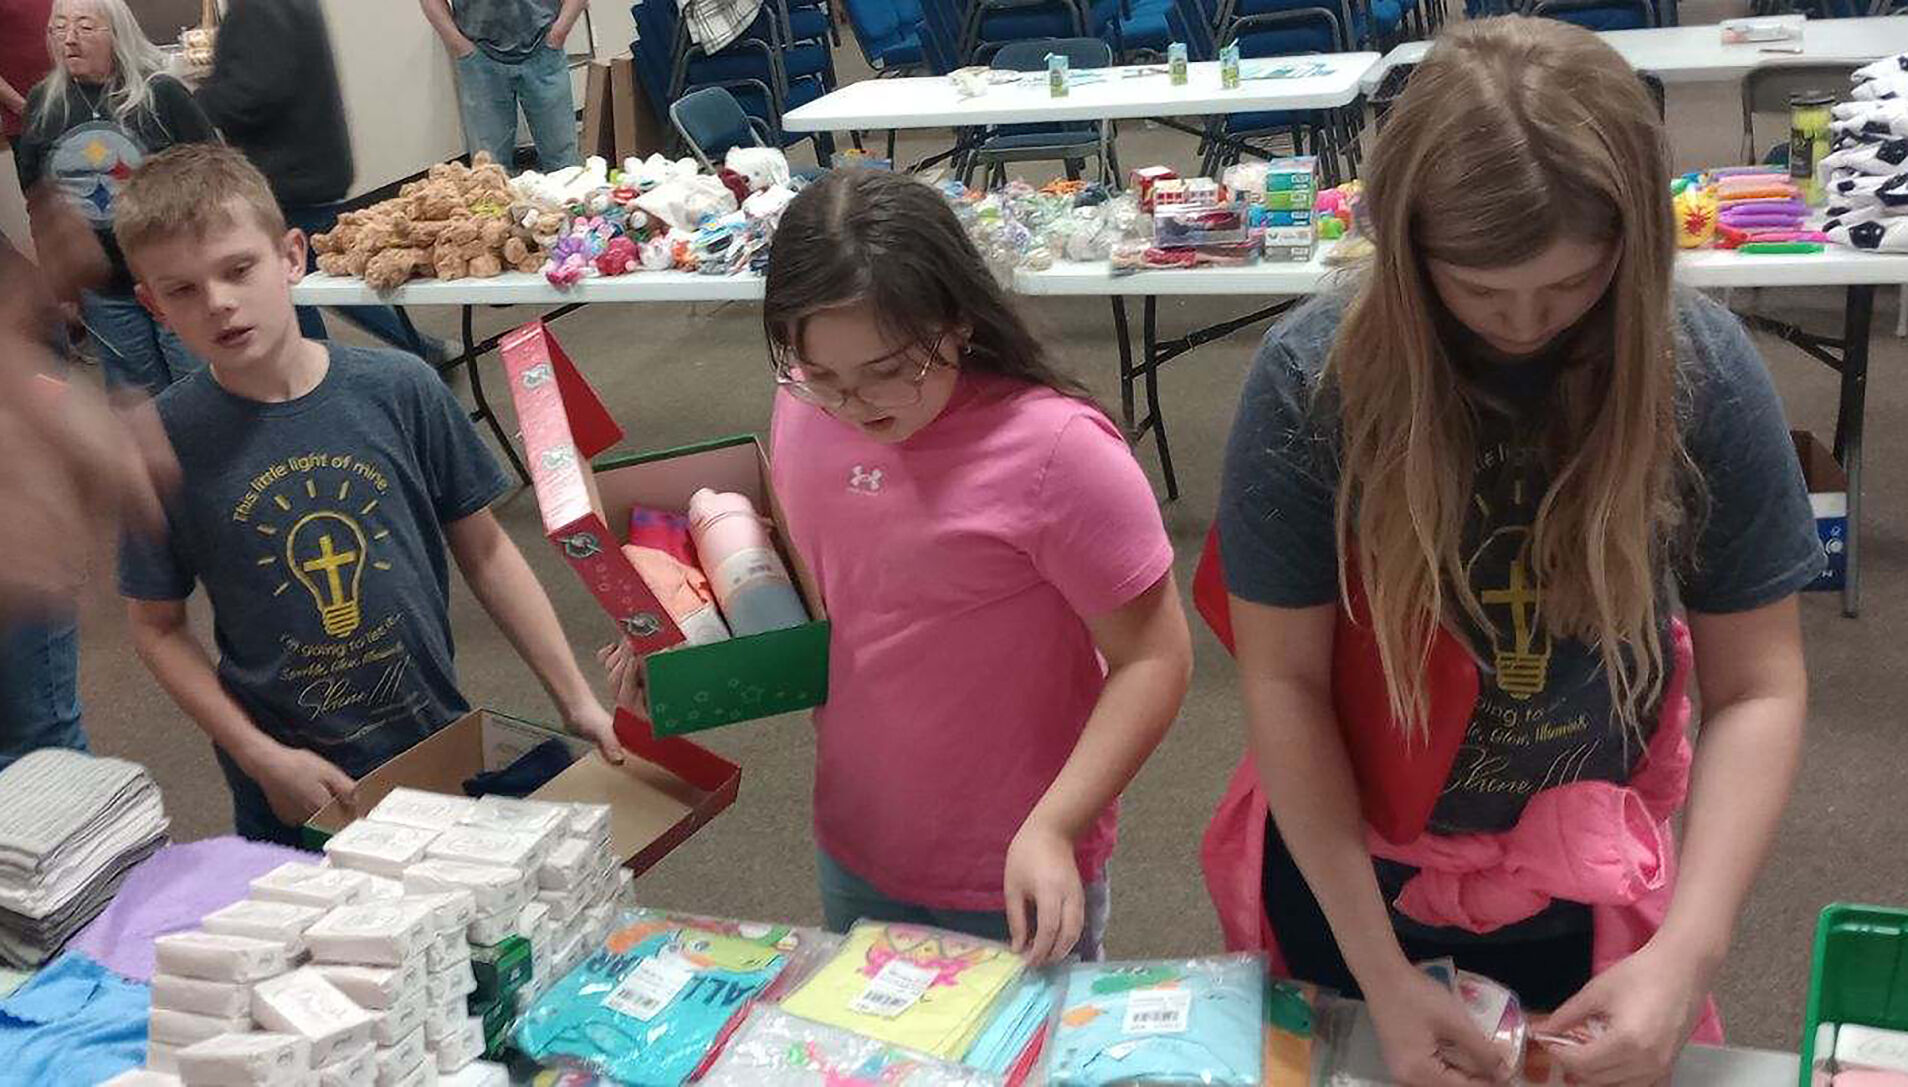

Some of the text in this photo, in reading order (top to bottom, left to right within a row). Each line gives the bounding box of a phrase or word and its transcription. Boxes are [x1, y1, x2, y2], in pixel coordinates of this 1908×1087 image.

[233, 491, 259, 522] This
[250, 463, 288, 493] little
[288, 452, 328, 472] light
[331, 454, 352, 469] of
